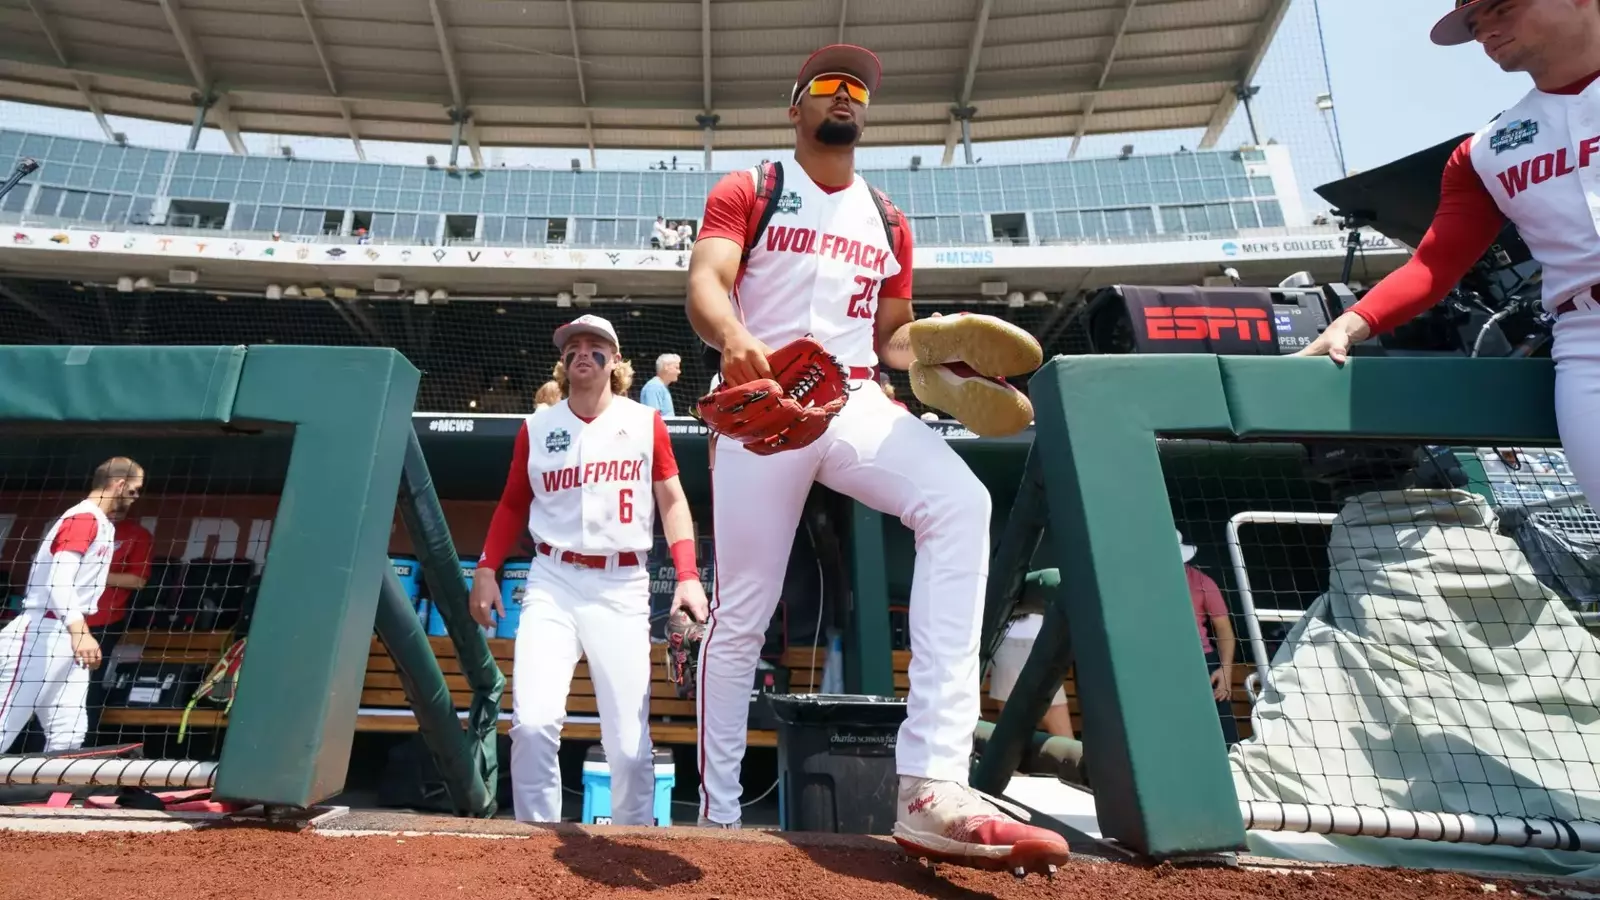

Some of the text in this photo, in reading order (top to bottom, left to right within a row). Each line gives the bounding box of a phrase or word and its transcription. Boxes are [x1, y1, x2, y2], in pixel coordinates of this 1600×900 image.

[766, 225, 891, 275] WOLFPACK
[935, 250, 994, 265] #MCWS
[1242, 242, 1280, 253] MEN'S
[1283, 239, 1336, 251] COLLEGE
[1144, 307, 1271, 341] ESPN
[1298, 336, 1311, 346] 95
[429, 419, 474, 432] #MCWS
[542, 459, 644, 493] WOLFPACK
[618, 488, 633, 524] 6
